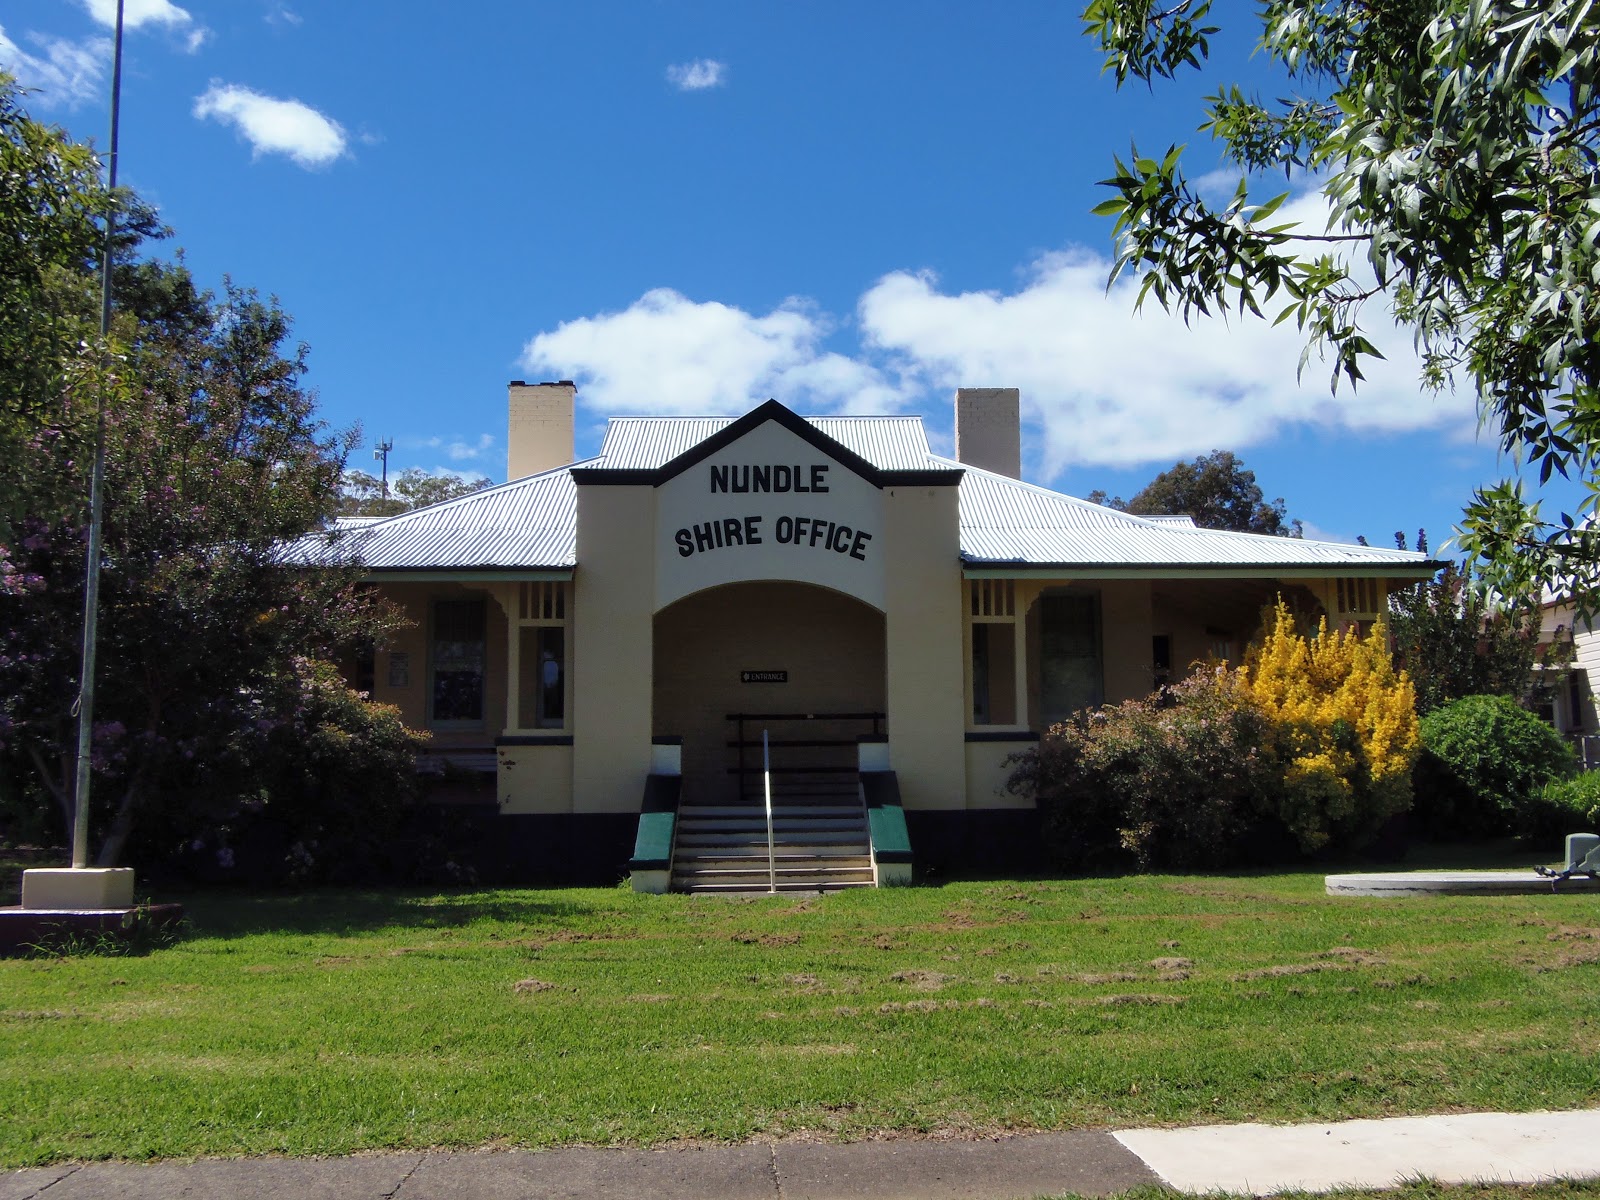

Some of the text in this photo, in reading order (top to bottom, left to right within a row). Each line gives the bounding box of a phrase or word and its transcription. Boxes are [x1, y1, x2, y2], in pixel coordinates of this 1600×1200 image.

[711, 465, 829, 493] NUNDLE
[675, 516, 873, 561] SHIRE OFFICE
[751, 672, 785, 681] ENTRANCE
